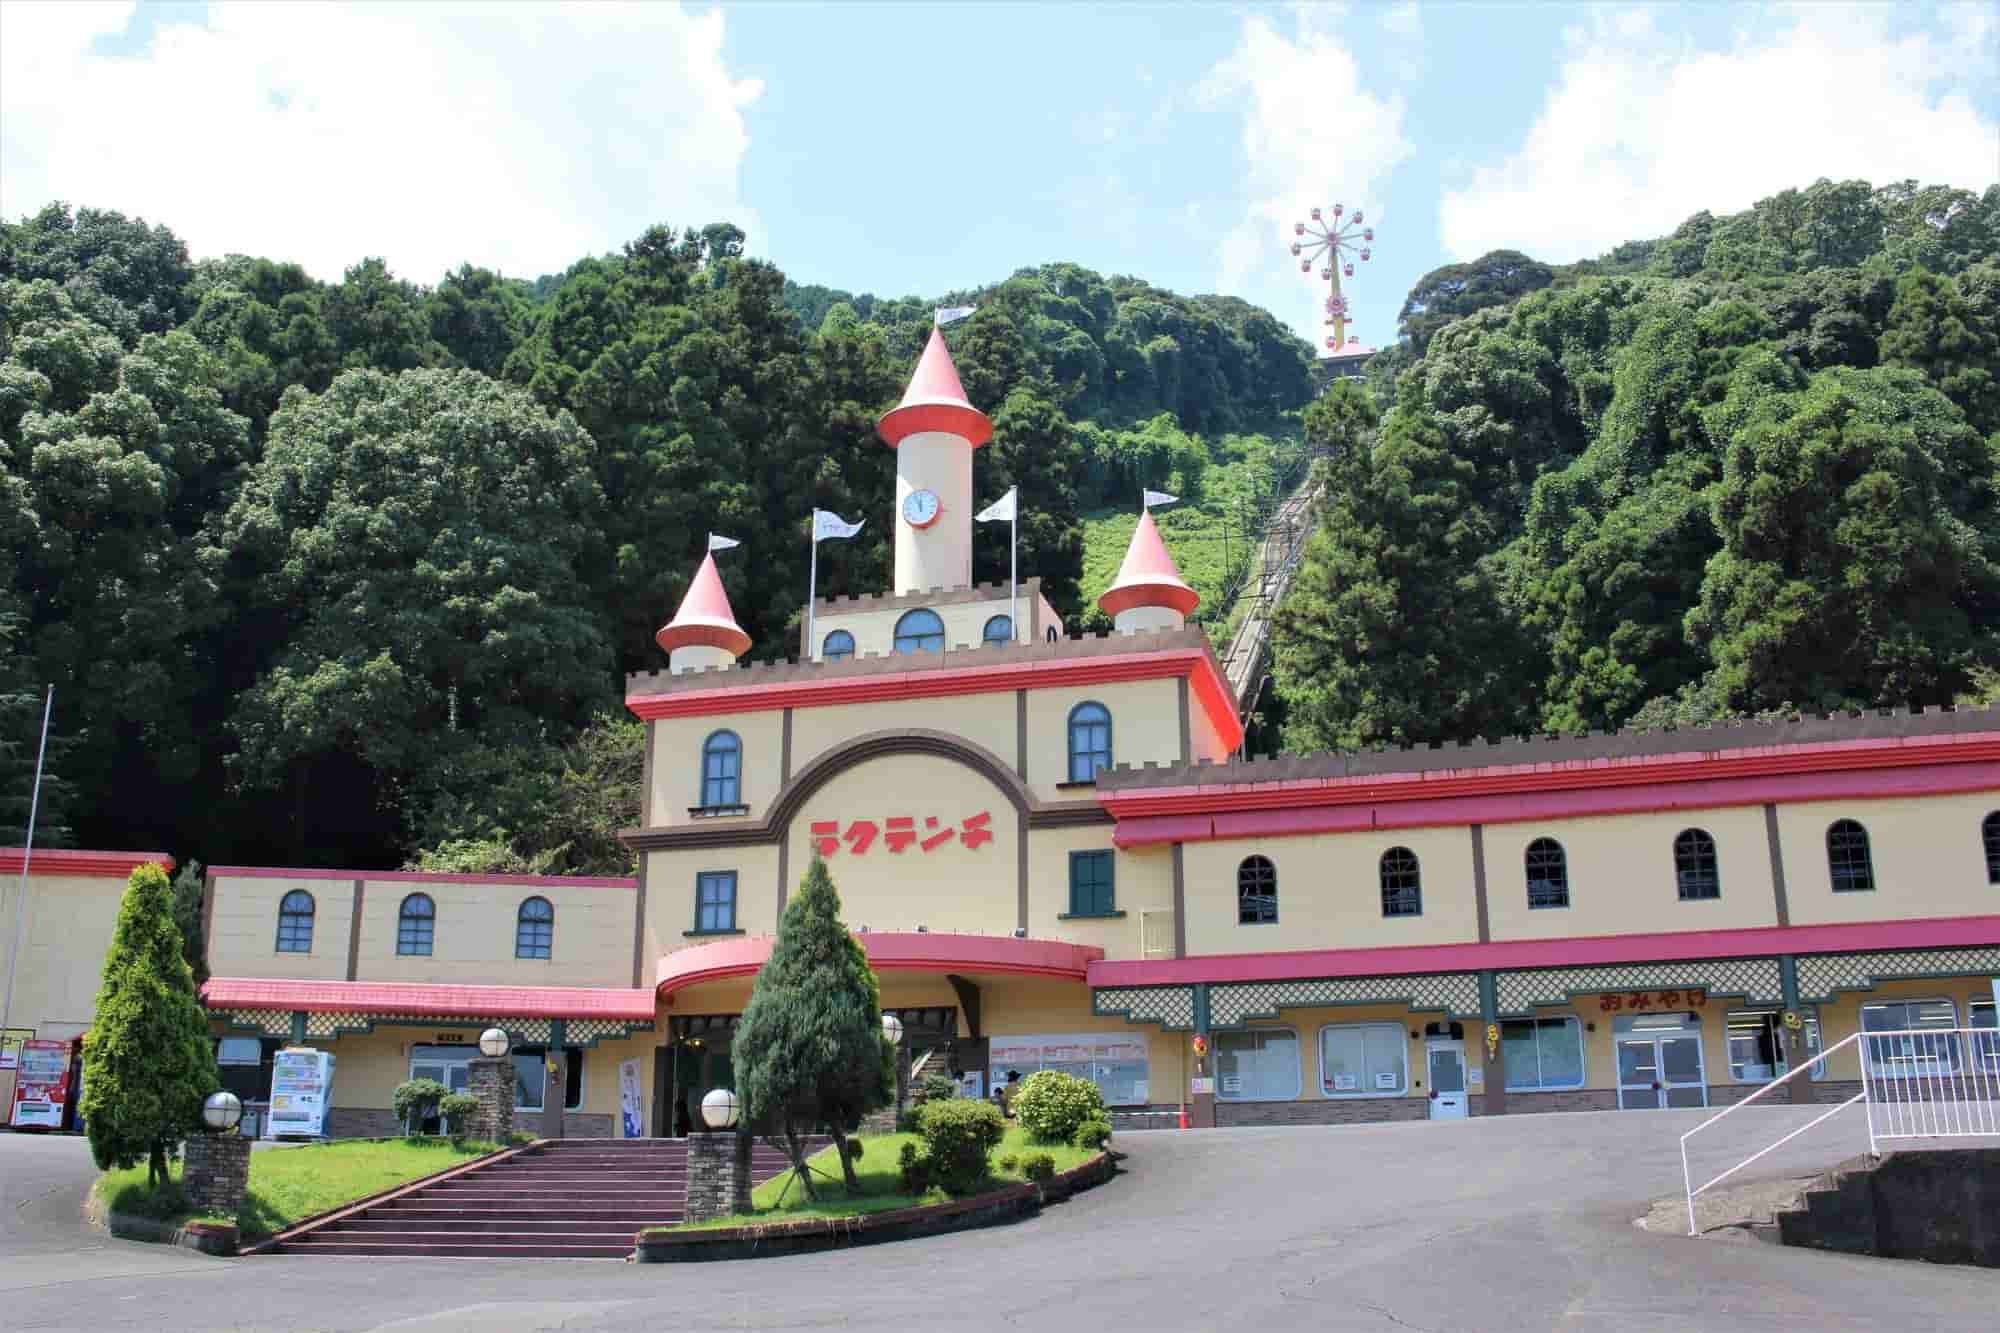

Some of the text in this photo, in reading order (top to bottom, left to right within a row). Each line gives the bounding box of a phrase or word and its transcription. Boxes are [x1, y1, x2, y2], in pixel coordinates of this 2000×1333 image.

[811, 810, 992, 857] ラクテンチ
